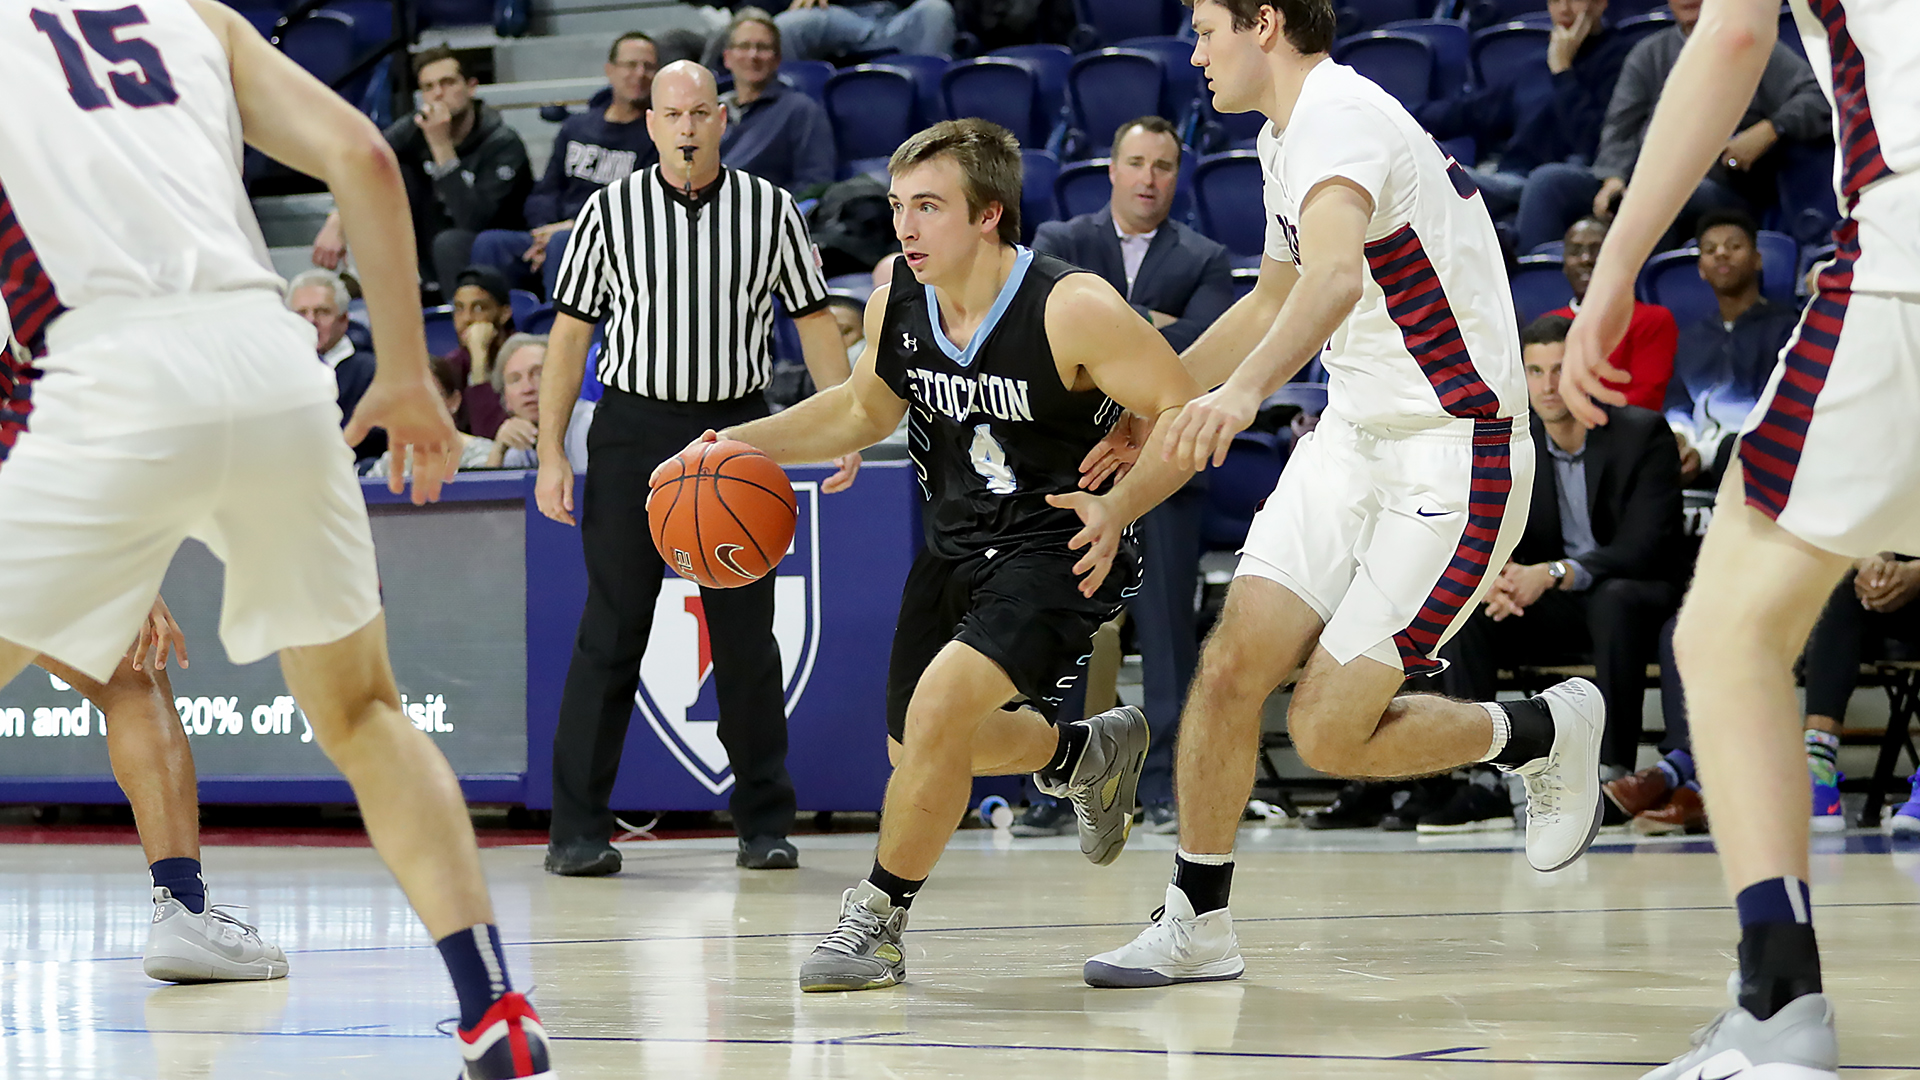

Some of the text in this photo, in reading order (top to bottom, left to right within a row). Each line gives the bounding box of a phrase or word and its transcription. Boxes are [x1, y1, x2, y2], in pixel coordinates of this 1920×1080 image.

[30, 4, 180, 112] 15
[564, 140, 637, 185] PENN
[968, 423, 1018, 495] 4
[32, 697, 91, 737] and
[174, 696, 243, 735] 20%
[251, 695, 294, 734] off
[400, 694, 454, 733] isit.
